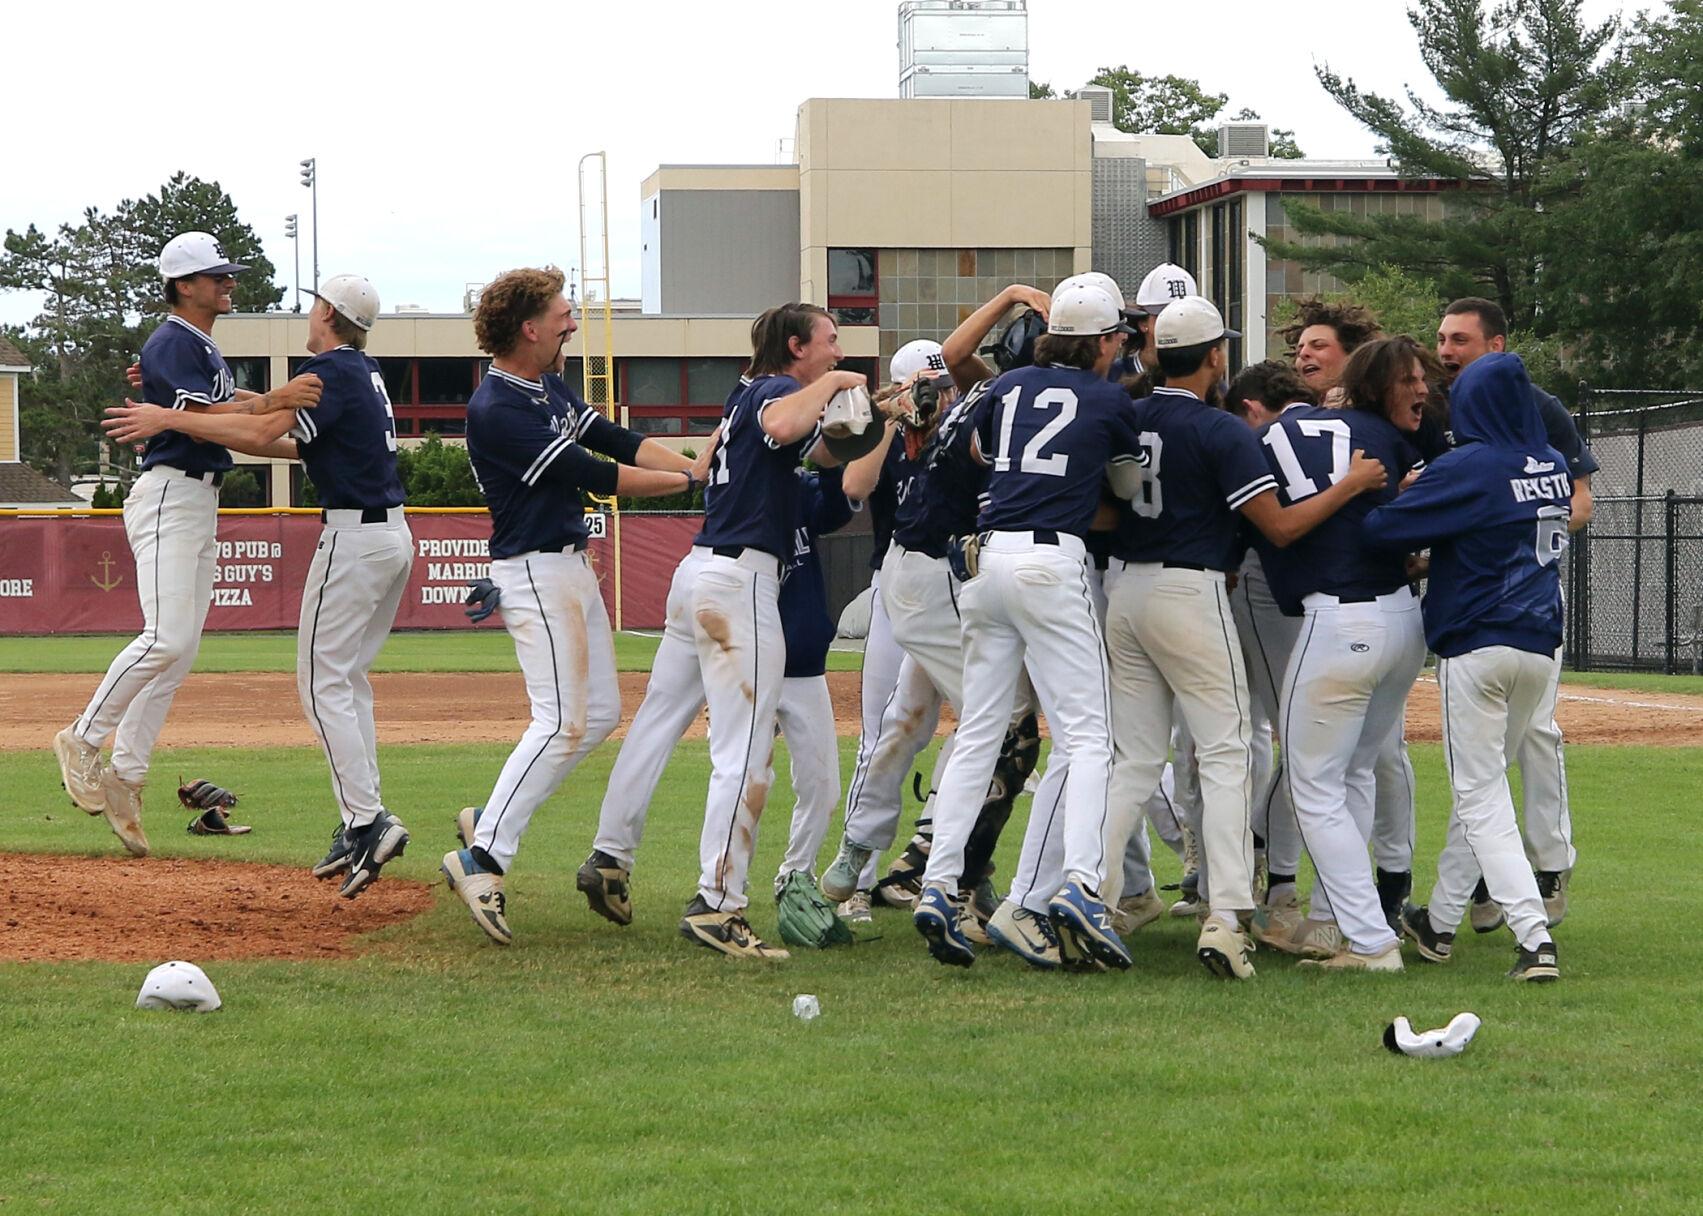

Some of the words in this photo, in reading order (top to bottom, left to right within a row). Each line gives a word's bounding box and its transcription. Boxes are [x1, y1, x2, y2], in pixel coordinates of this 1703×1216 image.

[994, 385, 1079, 477] 12
[1262, 418, 1351, 501] 17
[585, 516, 603, 535] 25
[234, 541, 269, 558] PUB
[418, 539, 490, 557] PROVIDE
[224, 564, 273, 582] GUY'S
[427, 562, 491, 580] MARRIO
[0, 578, 33, 597] ORE
[421, 586, 477, 604] DOWN
